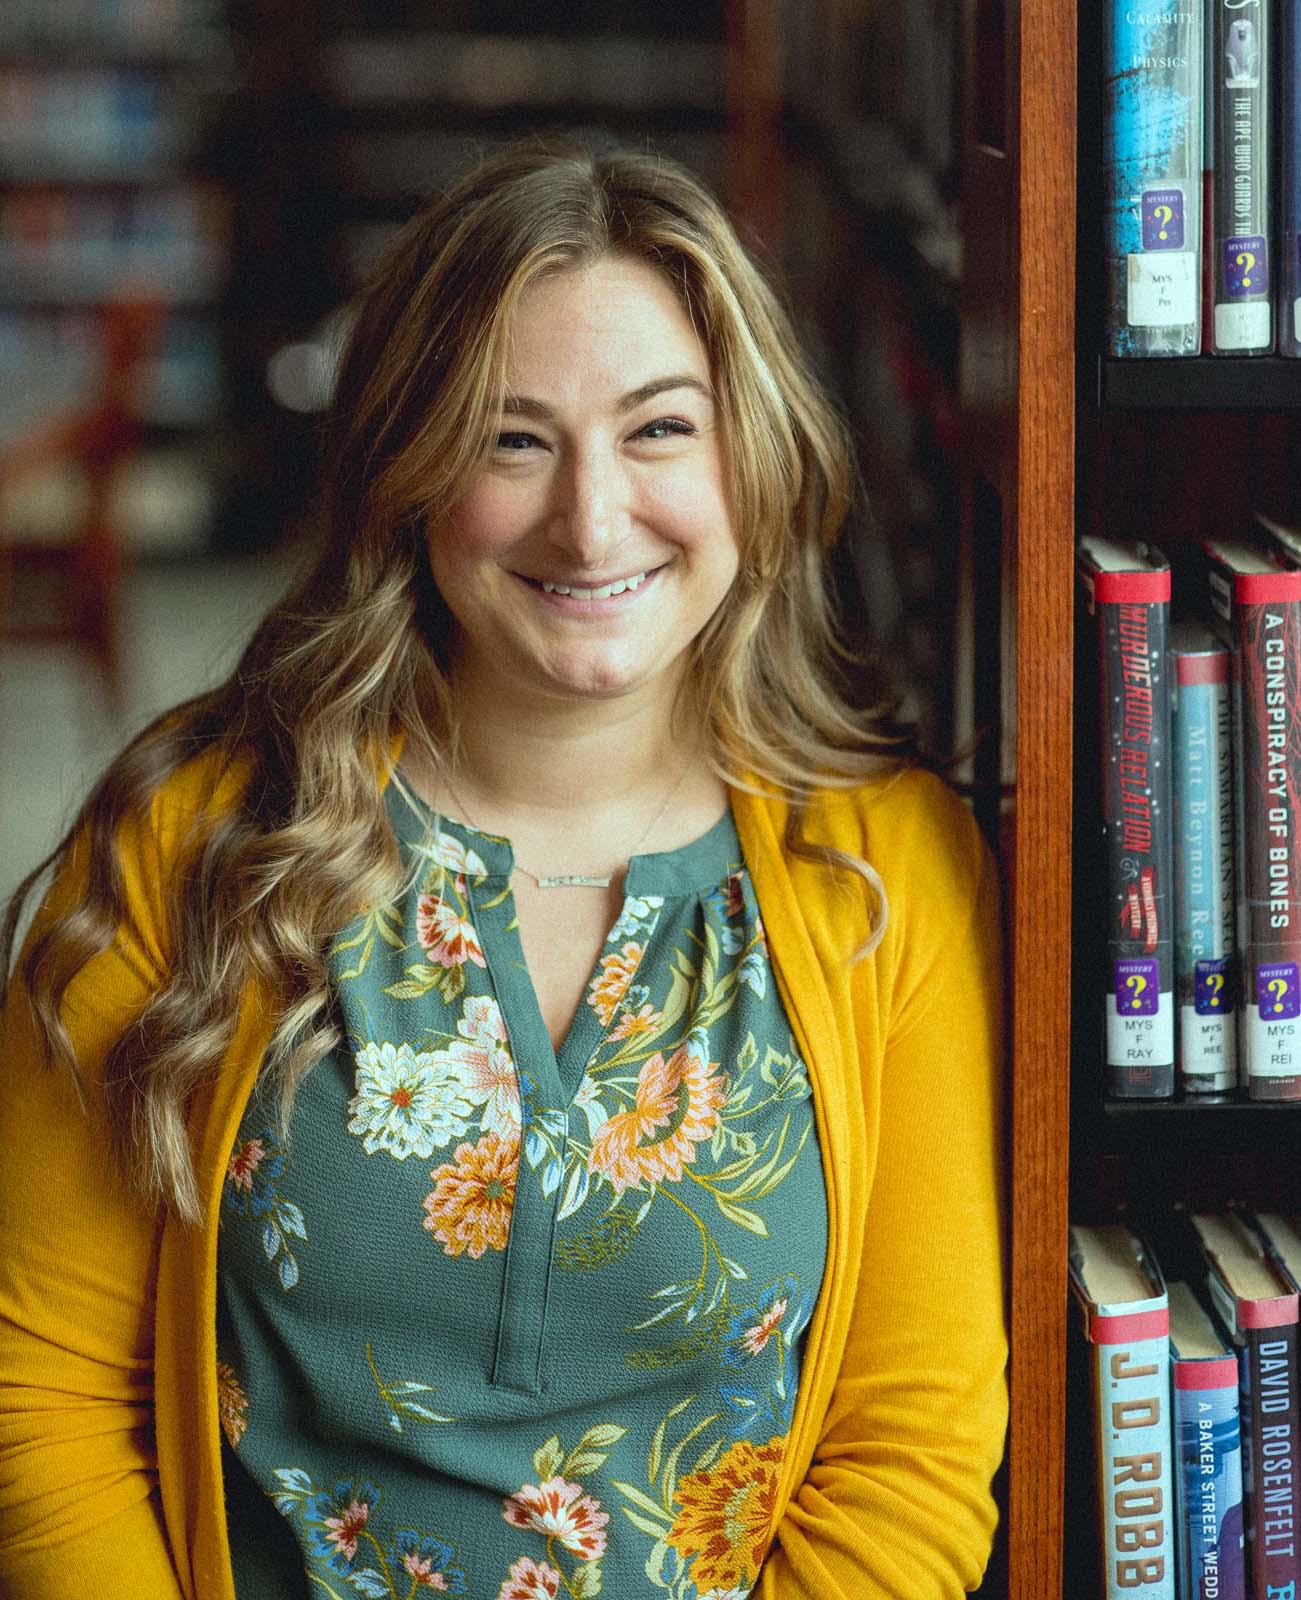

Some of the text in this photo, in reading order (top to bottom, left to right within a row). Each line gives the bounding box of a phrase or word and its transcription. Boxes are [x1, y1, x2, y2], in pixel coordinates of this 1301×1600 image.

[1234, 97, 1252, 235] THE APE WHO GUARDS TH
[1119, 603, 1153, 744] MURDEROUS
[1188, 726, 1208, 785] Matt
[1264, 613, 1290, 928] A CONSPIRACY OF BONES
[1120, 748, 1151, 853] RELATION
[1260, 968, 1294, 978] MYSTERY
[1125, 1020, 1153, 1031] MYS
[1127, 1049, 1153, 1059] RAY
[1135, 1034, 1144, 1044] F
[1201, 1024, 1222, 1033] MYS
[1267, 1025, 1295, 1036] MYS
[1277, 1039, 1285, 1051] F
[1270, 1054, 1292, 1065] REI
[1259, 1340, 1290, 1413] DAVID
[1111, 1351, 1165, 1589] J. D. ROBB
[1261, 1423, 1295, 1558] ROSENFELT
[1198, 1402, 1219, 1600] A BAKER STREET WEDD
